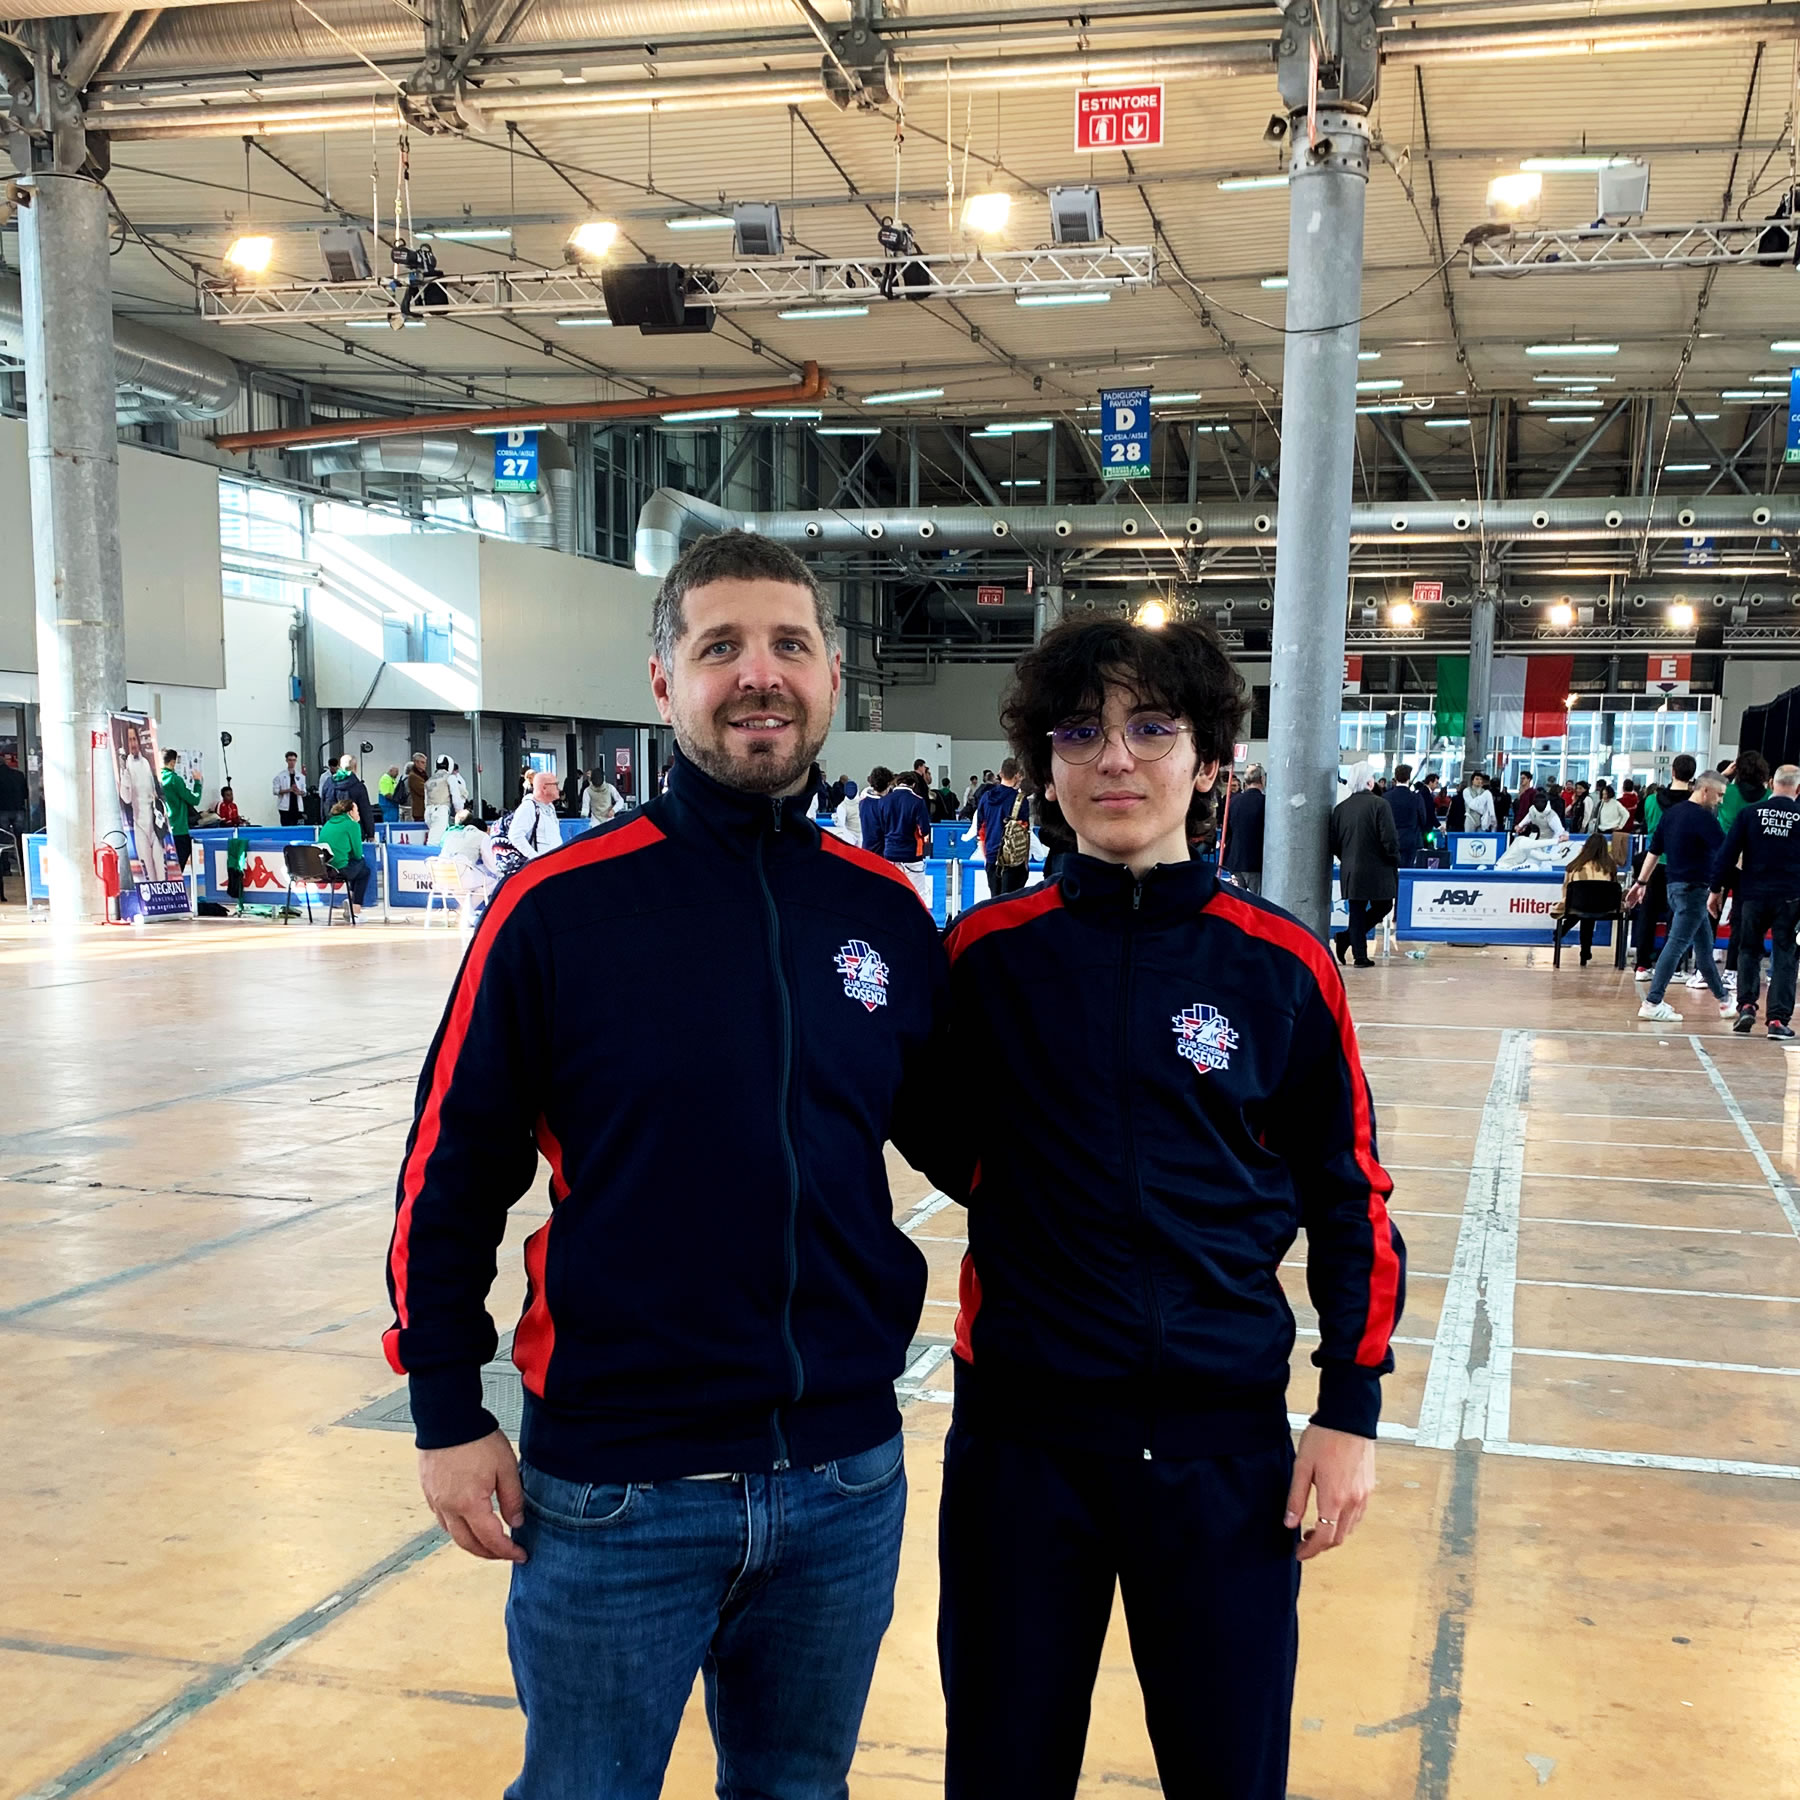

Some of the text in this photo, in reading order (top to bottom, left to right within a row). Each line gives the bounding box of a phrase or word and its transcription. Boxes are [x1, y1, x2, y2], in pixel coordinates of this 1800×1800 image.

[1081, 95, 1157, 111] ESTINTORE
[1103, 391, 1148, 400] PADIGLIONE
[1109, 399, 1142, 408] PAVILION
[1115, 408, 1136, 431] D
[507, 431, 525, 448] D
[1110, 443, 1141, 462] 28
[503, 458, 529, 476] 27
[1660, 659, 1678, 679] E
[1756, 808, 1800, 821] TECNICO
[1761, 817, 1793, 829] DELLE
[1763, 826, 1789, 837] ARMI
[150, 881, 185, 896] NEGRINI
[1509, 898, 1552, 914] Hilter
[843, 978, 861, 988] CLUB
[844, 985, 888, 1006] COSENZA
[1177, 1037, 1197, 1049] CLUB
[1177, 1044, 1229, 1070] COSENZA
